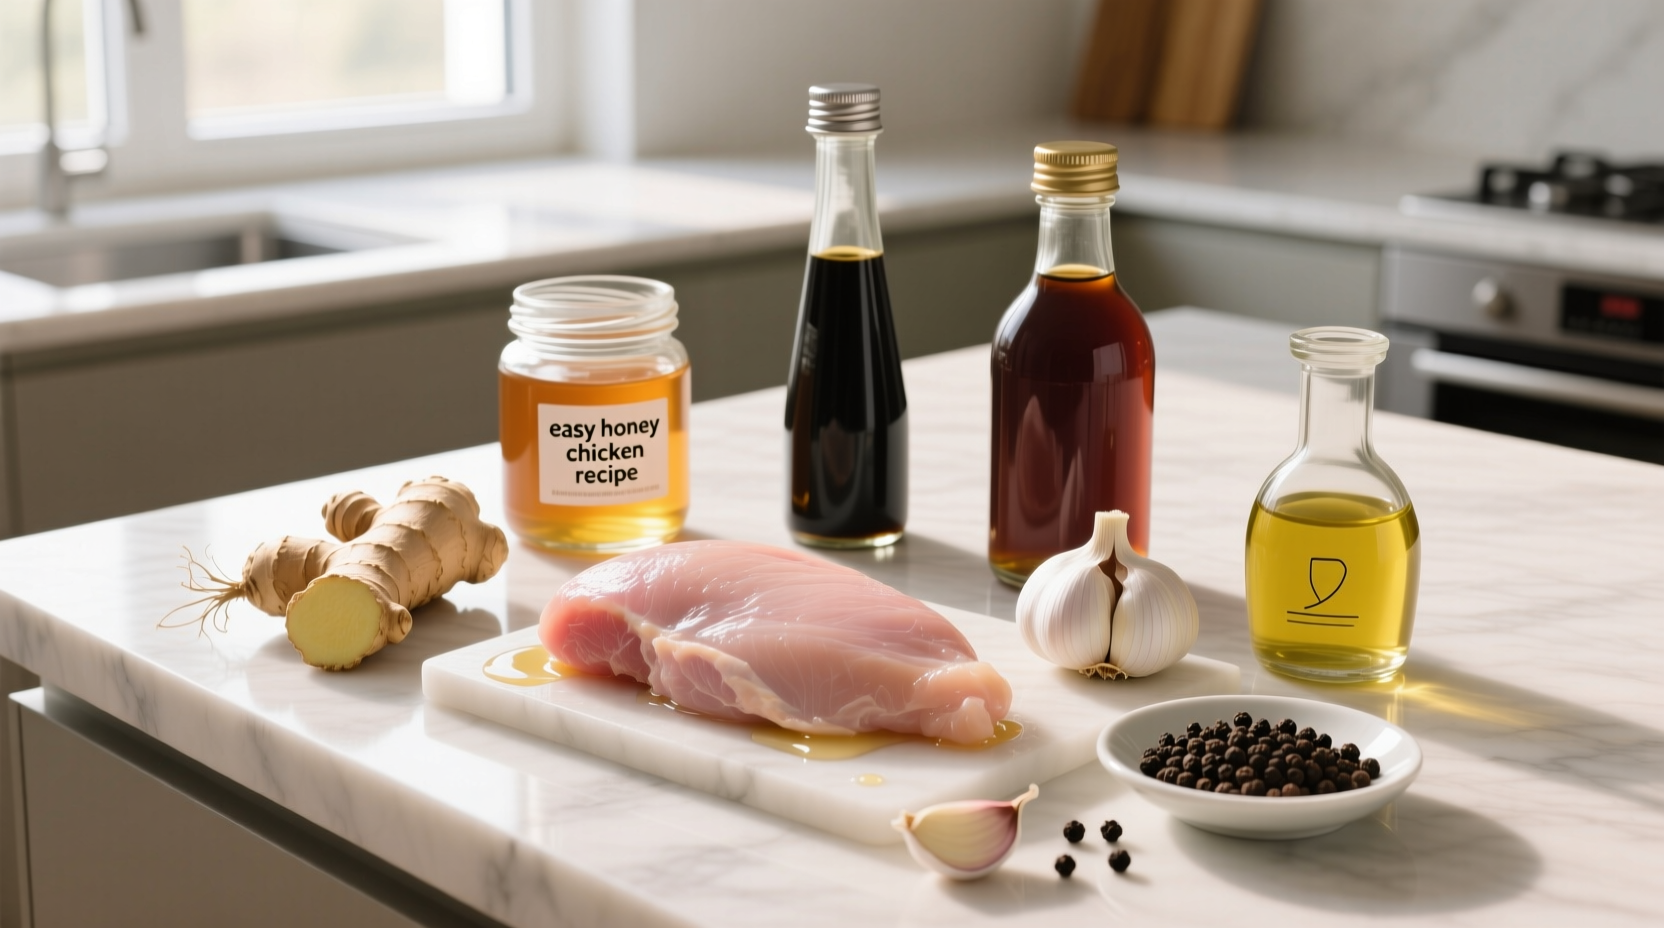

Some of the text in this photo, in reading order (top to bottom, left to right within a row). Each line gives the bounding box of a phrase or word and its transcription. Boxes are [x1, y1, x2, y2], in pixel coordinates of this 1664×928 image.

[549, 418, 660, 443] easy honey
[566, 442, 644, 462] chicken
[575, 464, 638, 487] recipe
